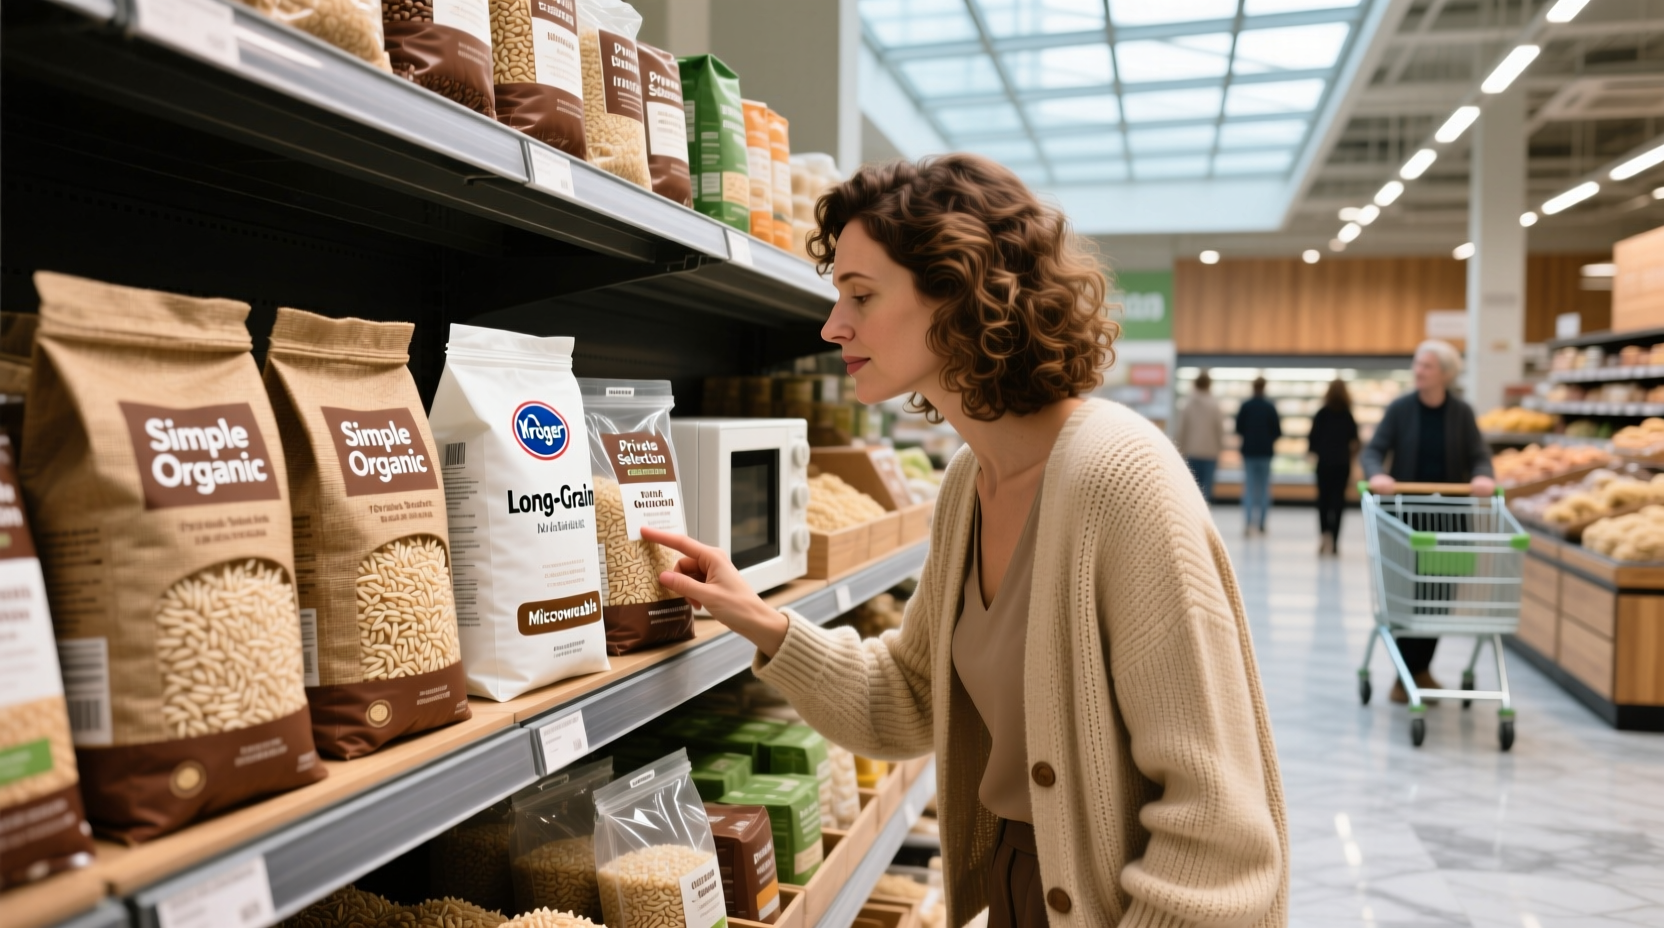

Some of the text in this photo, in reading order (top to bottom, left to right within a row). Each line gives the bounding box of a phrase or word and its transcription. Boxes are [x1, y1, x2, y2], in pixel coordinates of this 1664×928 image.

[145, 417, 250, 459] Simple
[340, 419, 412, 453] Simple
[518, 413, 564, 447] Kroger
[151, 451, 268, 496] Organic
[348, 448, 428, 484] Organic
[507, 483, 594, 518] Long-Grain
